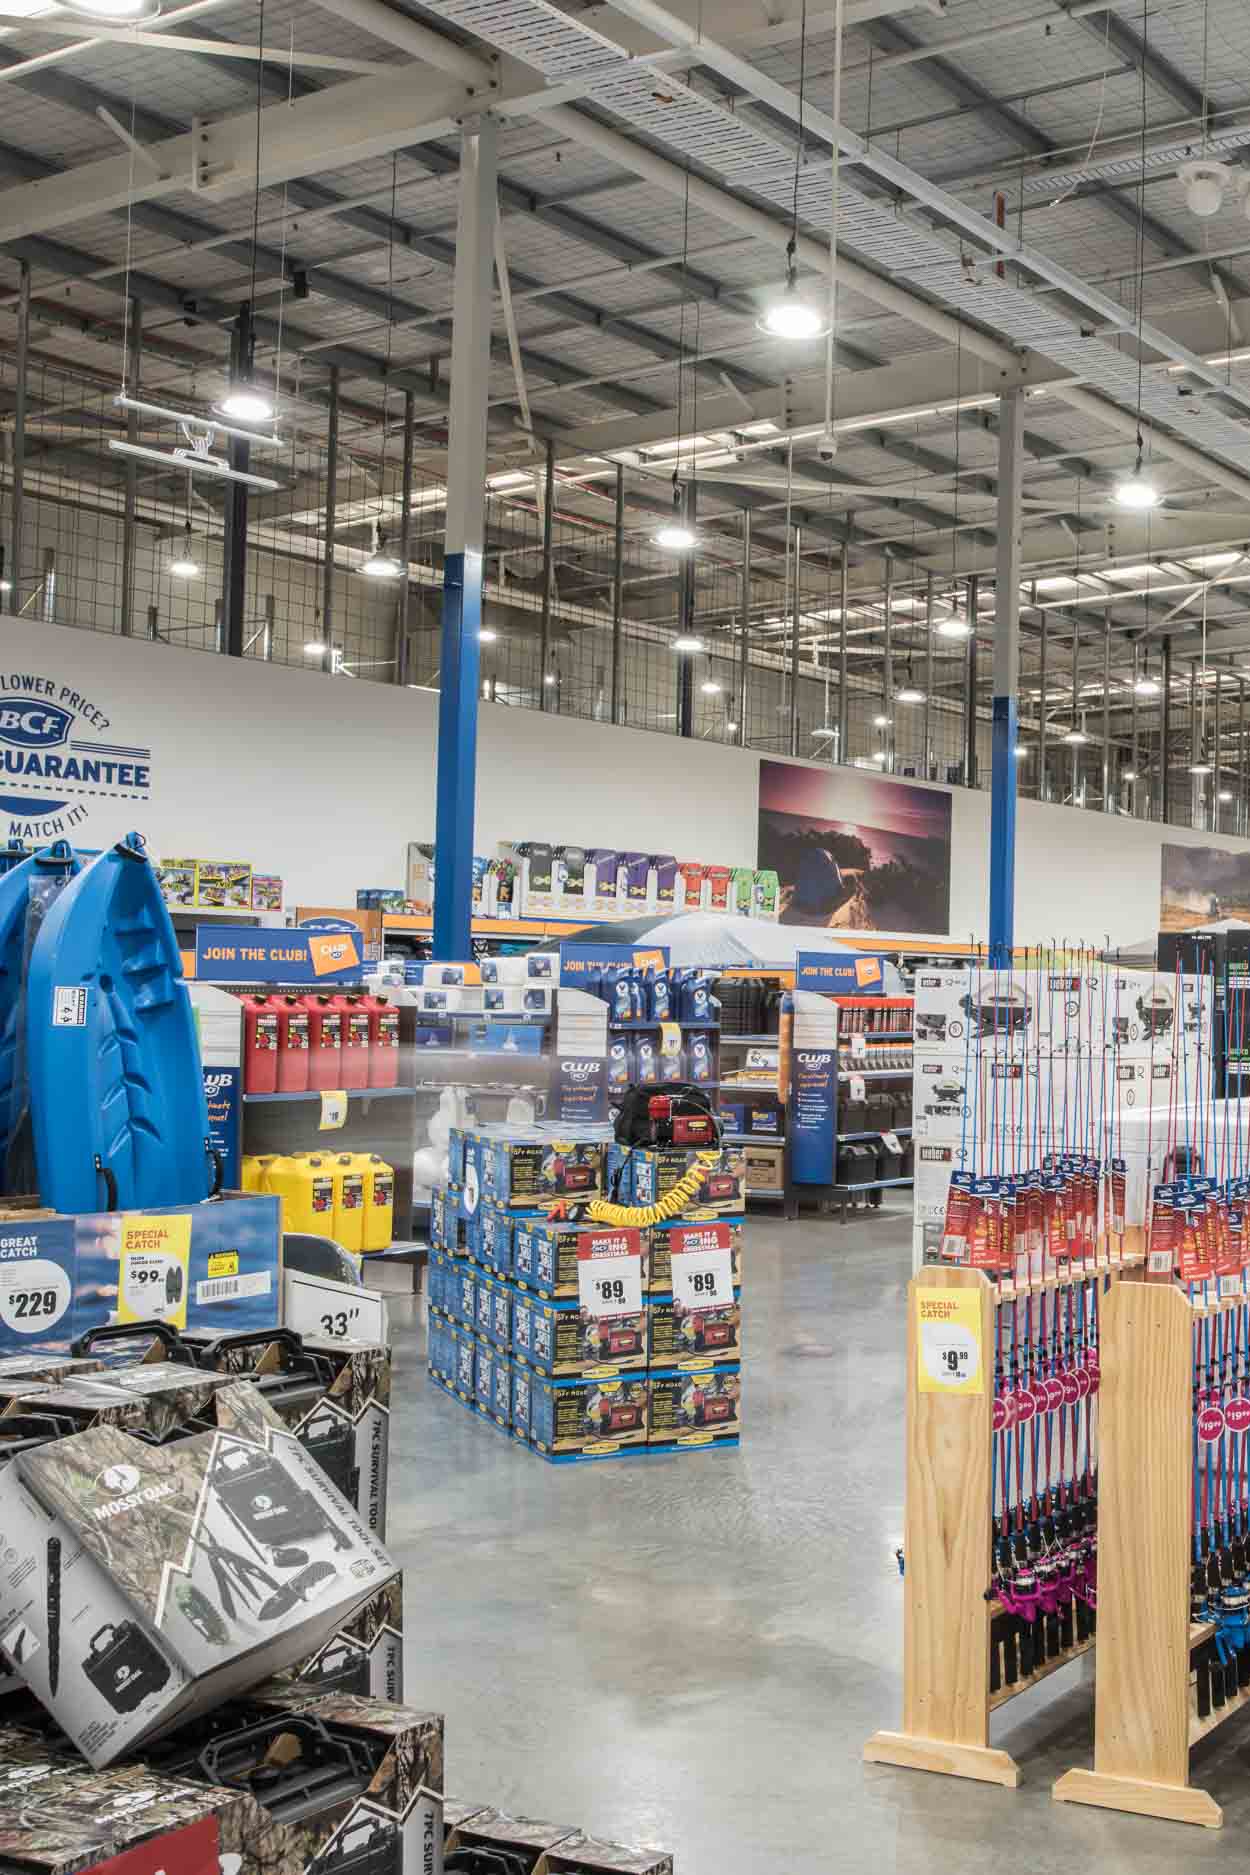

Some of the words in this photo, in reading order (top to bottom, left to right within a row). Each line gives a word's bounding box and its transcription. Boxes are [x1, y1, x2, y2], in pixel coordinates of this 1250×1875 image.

[1, 674, 56, 696] LOWER
[59, 687, 110, 732] PRICE?
[9, 819, 65, 838] MATCH
[66, 803, 89, 827] IT!
[202, 947, 236, 961] JOIN
[239, 948, 267, 961] THE
[270, 949, 308, 961] CLUB!
[798, 1052, 832, 1064] CLUB
[561, 1061, 601, 1073] CLUB
[127, 1229, 169, 1241] SPECIAL
[0, 1236, 38, 1248] GREAT
[126, 1240, 161, 1250] CATCH
[0, 1247, 38, 1259] CATCH
[688, 1272, 716, 1292] $89
[595, 1279, 624, 1300] $89
[9, 1290, 57, 1319] $229
[920, 1300, 960, 1310] SPECIAL
[920, 1310, 951, 1319] CATCH
[369, 1443, 382, 1499] SURVIVAL
